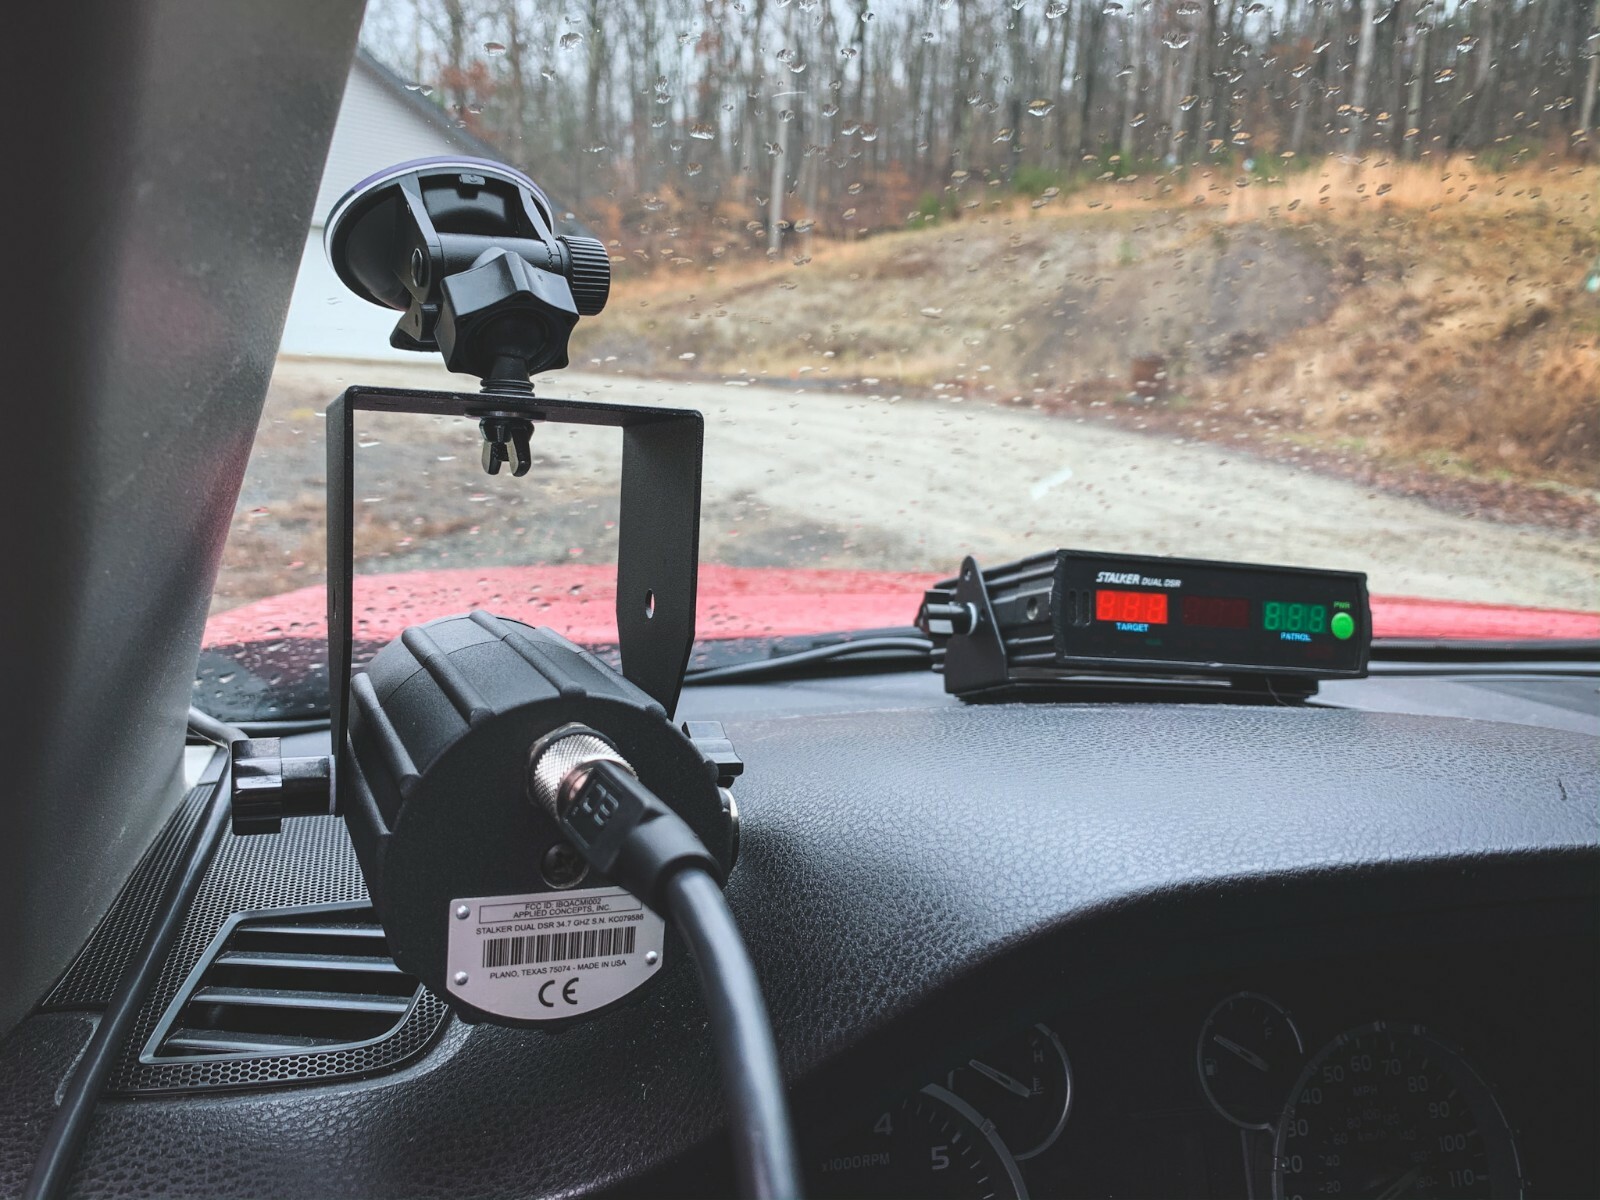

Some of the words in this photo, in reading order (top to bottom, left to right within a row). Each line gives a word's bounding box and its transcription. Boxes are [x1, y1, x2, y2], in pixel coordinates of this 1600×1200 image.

[1096, 571, 1140, 585] STALKER
[1141, 577, 1162, 587] DUAL
[1163, 578, 1182, 588] DSR
[1115, 622, 1149, 632] TARGET
[1280, 632, 1312, 642] PATROL
[513, 909, 548, 919] APPLIED
[549, 905, 595, 916] CONCEPTS,
[525, 902, 542, 911] FCC
[475, 925, 513, 935] STALKER
[514, 923, 536, 932] DUAL
[537, 921, 555, 930] DSR
[556, 920, 572, 928] 34.7
[573, 918, 590, 926] GHZ
[489, 970, 520, 980] PLANO,
[522, 967, 548, 976] TEXAS
[549, 965, 571, 974] 75074
[577, 962, 600, 971] MADE
[601, 961, 609, 969] IN
[611, 959, 627, 968] USA
[538, 977, 579, 1008] CE
[1350, 1054, 1372, 1073] 60
[1381, 1058, 1401, 1077] 70
[1323, 1065, 1344, 1083] 50
[1407, 1074, 1429, 1093] 80
[1301, 1087, 1322, 1105] 40
[1352, 1085, 1379, 1097] MPH
[1428, 1100, 1450, 1119] 90
[873, 1111, 894, 1136] 4
[1438, 1133, 1466, 1153] 100
[930, 1145, 950, 1171] 5
[1448, 1168, 1475, 1188] 110
